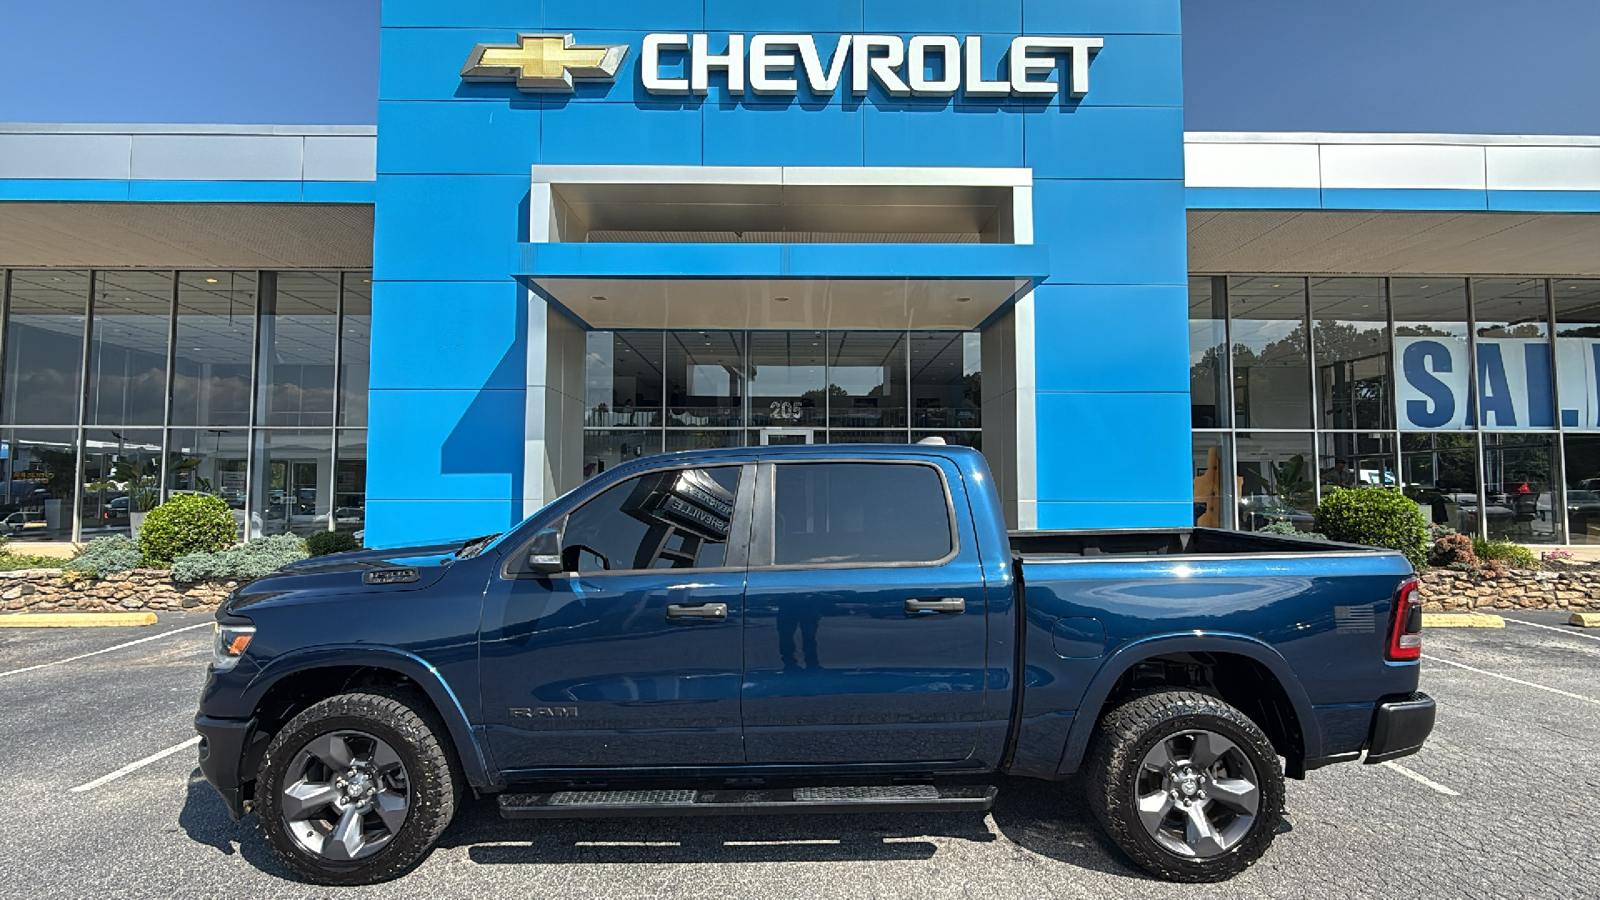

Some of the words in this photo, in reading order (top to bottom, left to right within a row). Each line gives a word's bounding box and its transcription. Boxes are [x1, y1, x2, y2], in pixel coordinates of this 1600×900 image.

[641, 33, 1104, 96] CHEVROLET
[1402, 340, 1600, 428] SAL
[769, 401, 804, 419] 205
[508, 706, 579, 718] RAM
